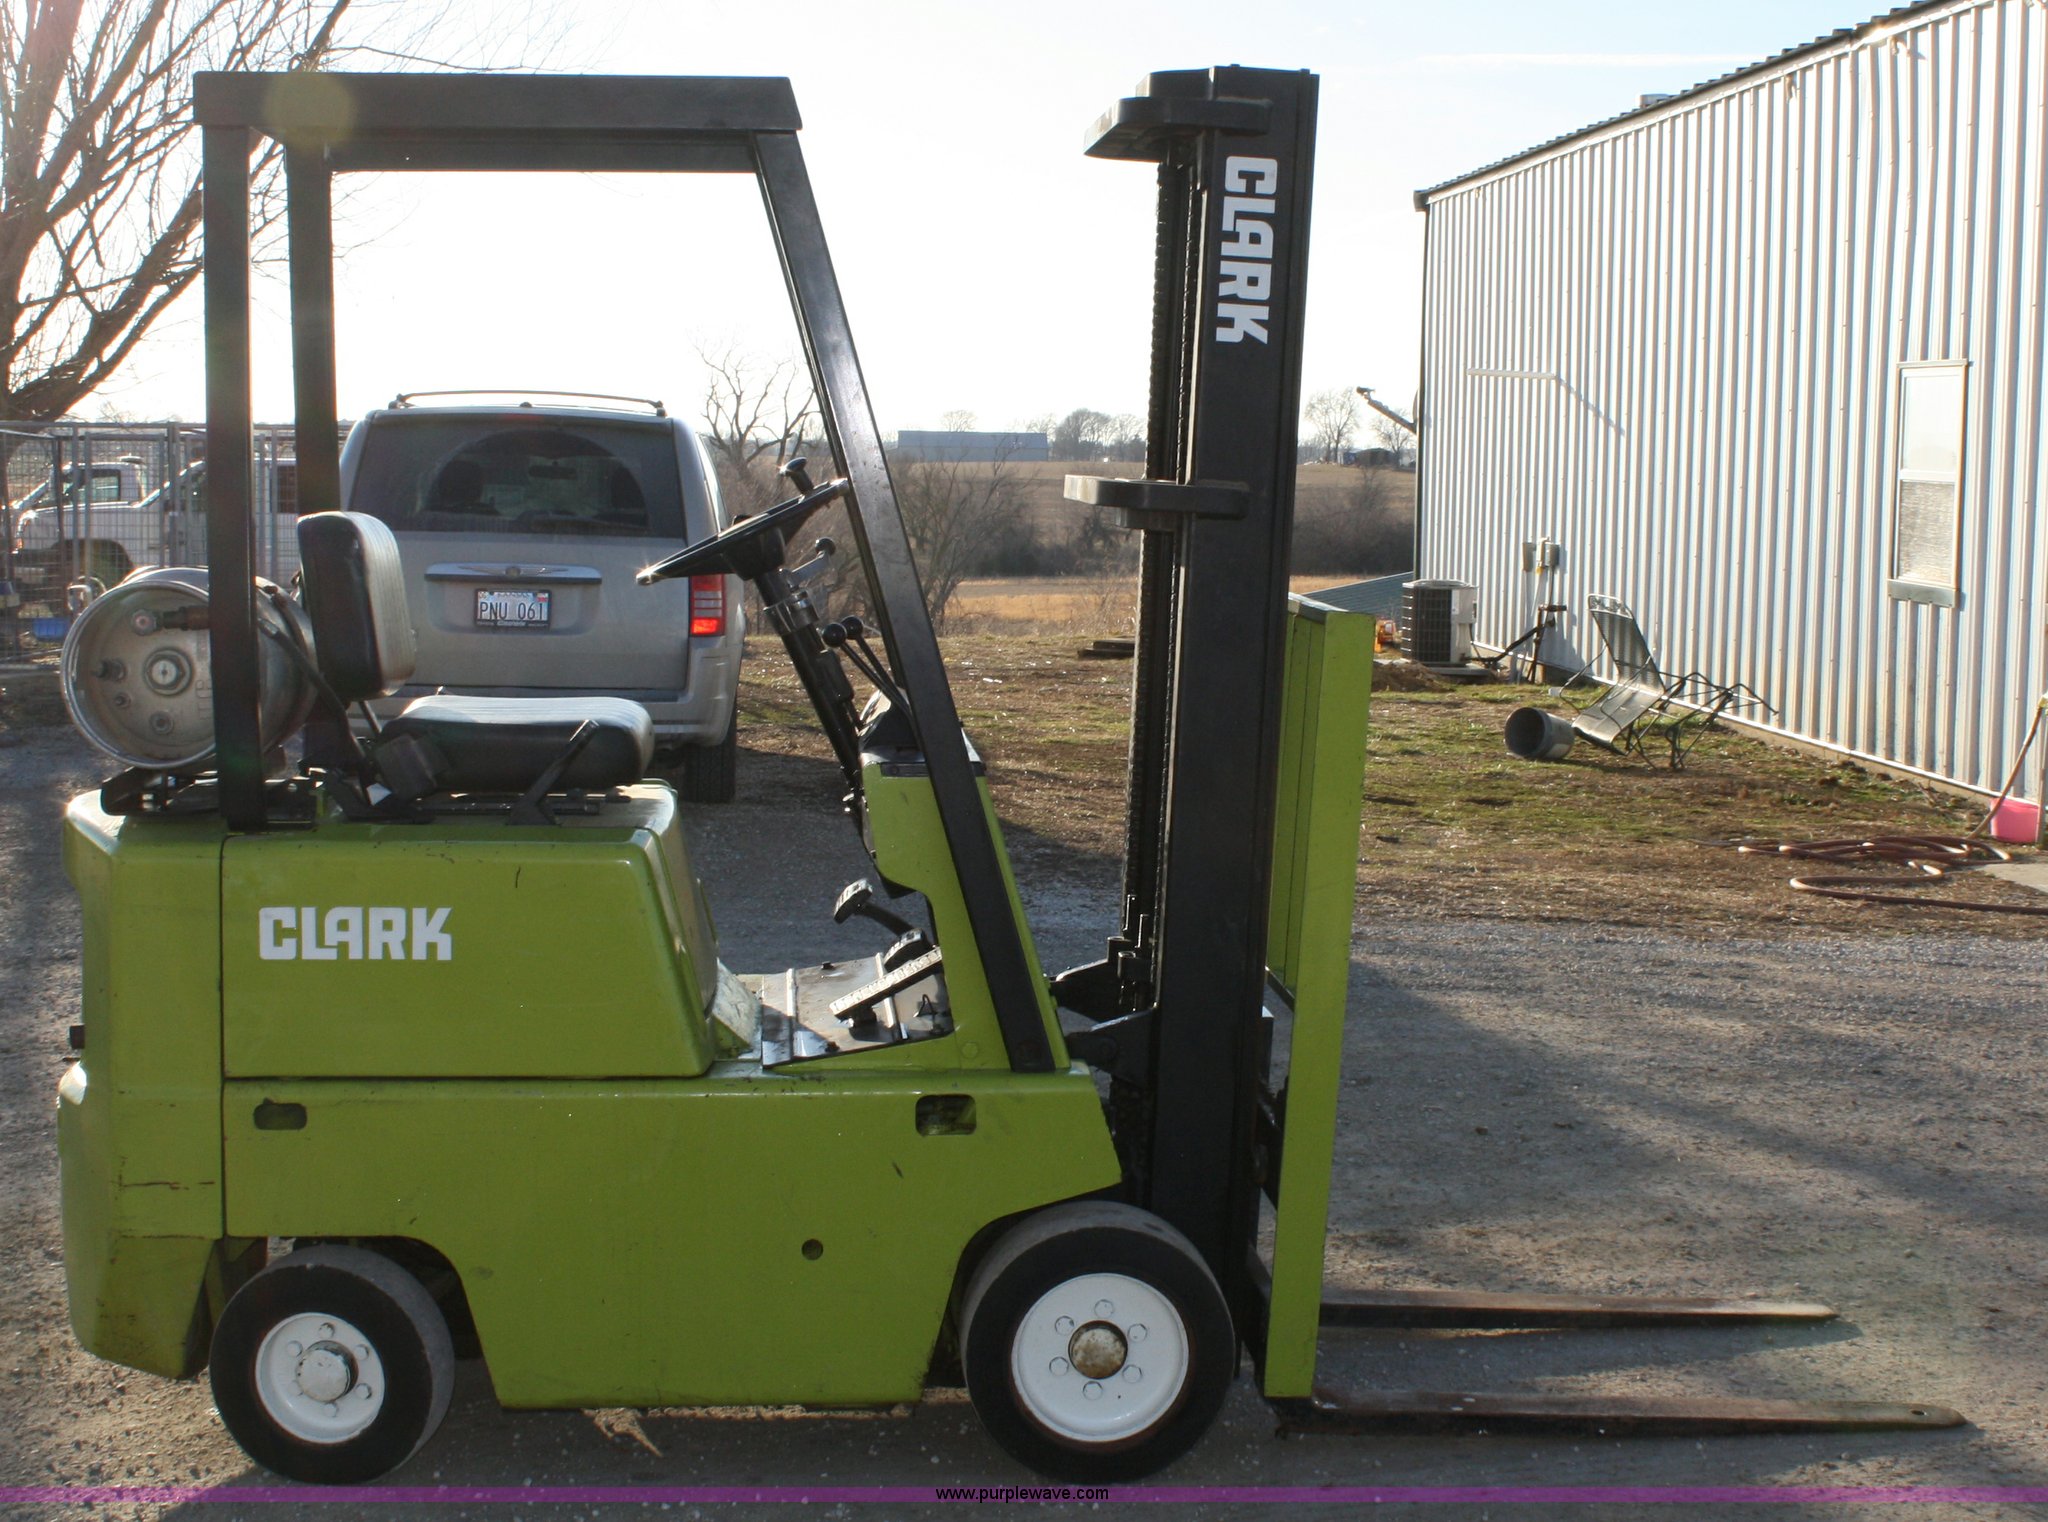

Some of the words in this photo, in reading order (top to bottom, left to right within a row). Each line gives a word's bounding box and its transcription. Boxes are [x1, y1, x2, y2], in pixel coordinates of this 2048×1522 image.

[1216, 156, 1278, 344] CLARK
[480, 602, 508, 620] PNU
[517, 602, 543, 620] 061
[259, 906, 452, 960] CLARK
